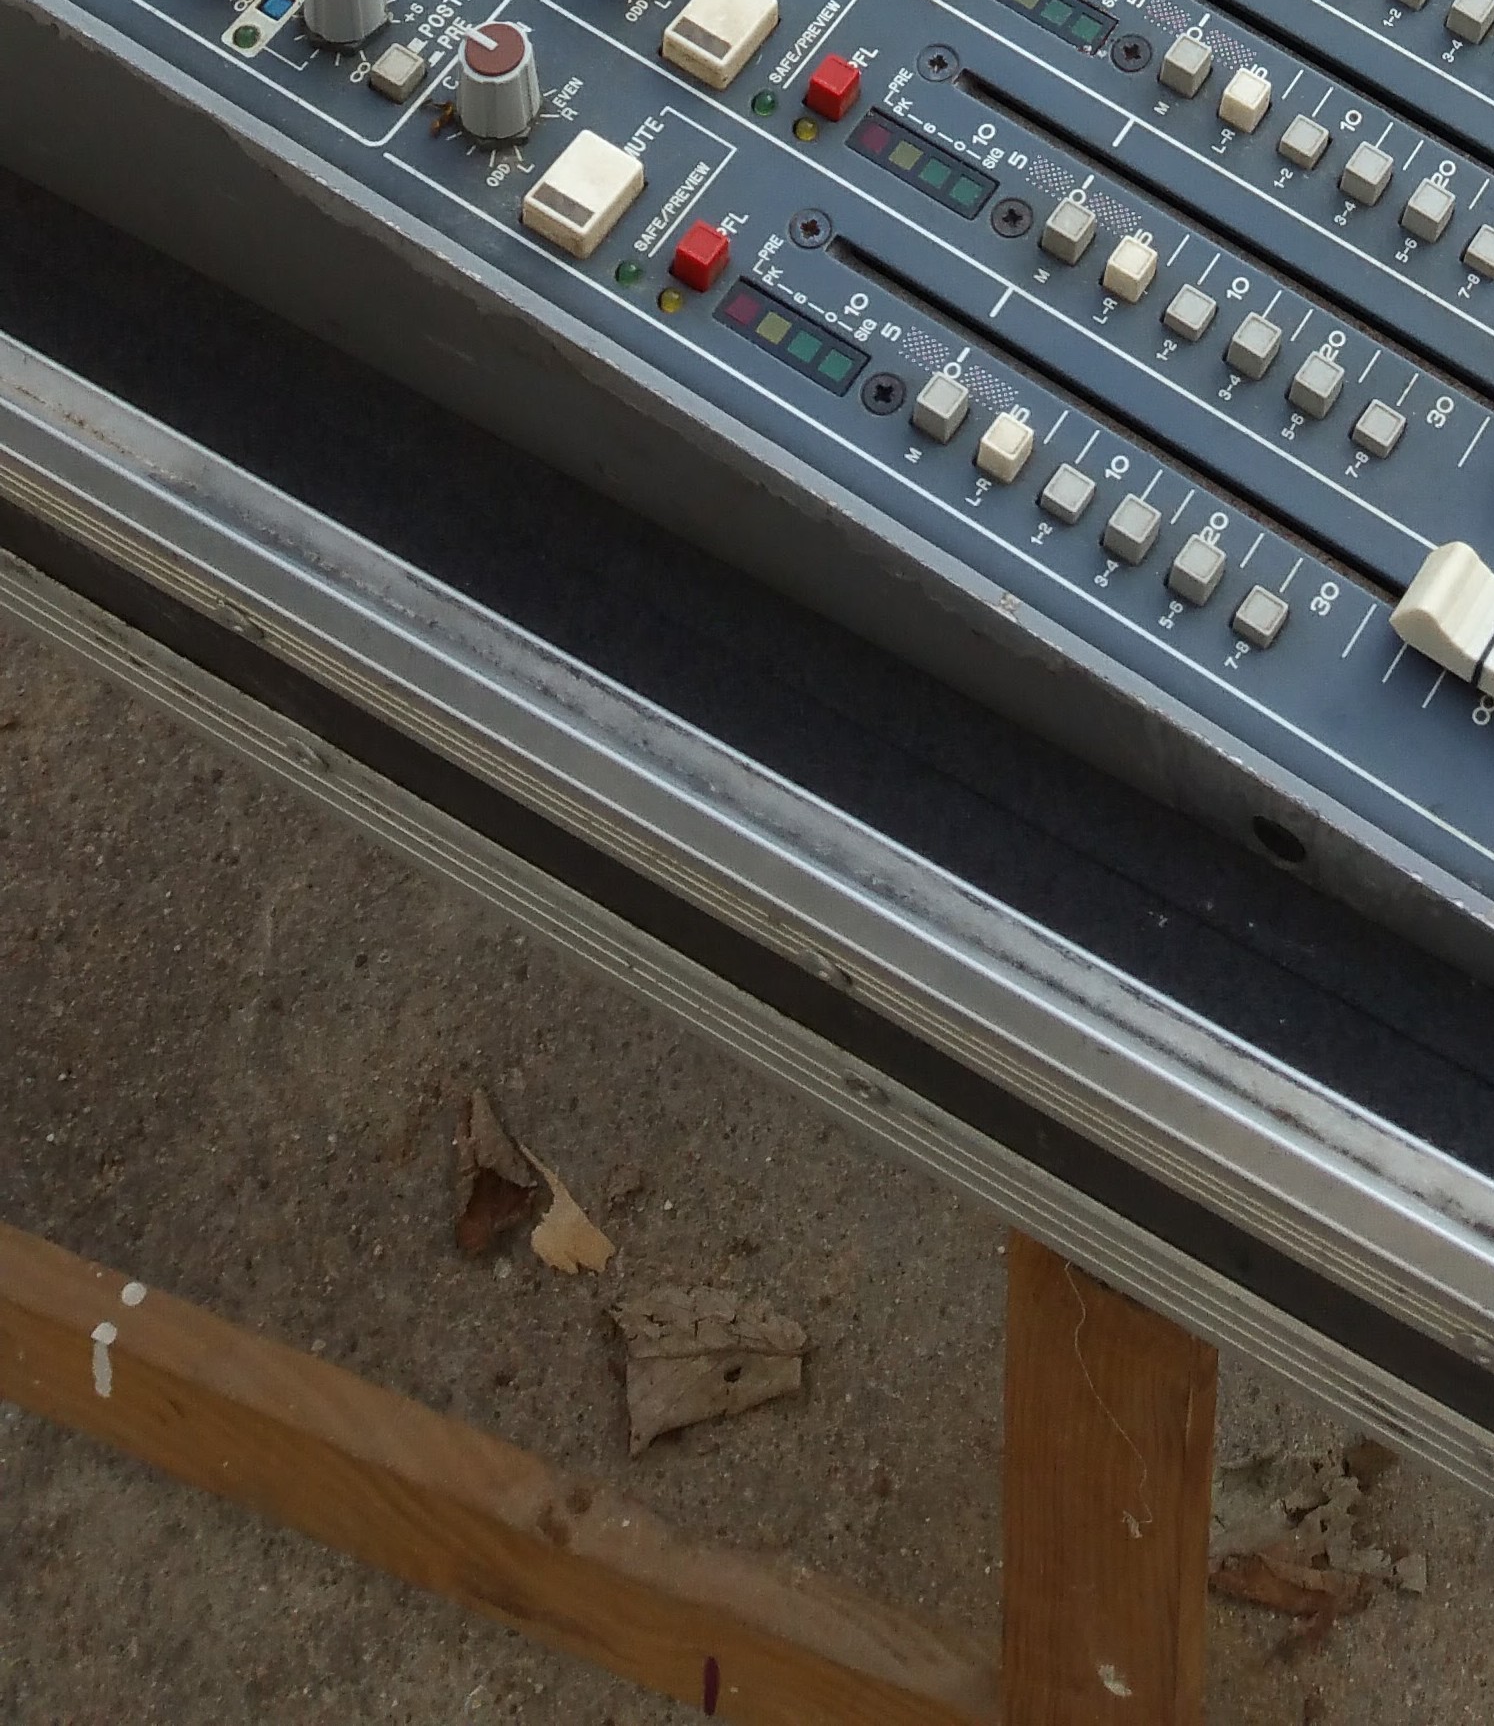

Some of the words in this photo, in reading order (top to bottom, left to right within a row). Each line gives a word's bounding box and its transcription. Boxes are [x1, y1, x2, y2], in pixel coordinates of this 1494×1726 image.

[403, 2, 425, 23] +6
[1383, 9, 1402, 29] 1-2
[552, 77, 584, 108] EVEN
[889, 68, 913, 97] PRE
[893, 98, 913, 118] PK
[1155, 101, 1171, 116] M
[1339, 109, 1364, 134] 10
[972, 123, 996, 148] 10
[1210, 127, 1236, 154] L-R
[982, 148, 1005, 170] SIG
[1009, 152, 1029, 170] 5
[487, 162, 512, 187] ODD
[1272, 167, 1294, 189] 1-2
[633, 161, 711, 254] SAFE/PREVIEW
[1333, 201, 1358, 228] 3-4
[759, 233, 783, 265] PRE
[1395, 237, 1418, 264] 5-6
[762, 266, 782, 287] PK
[1033, 268, 1051, 284] M
[1225, 275, 1251, 301] 10
[1457, 273, 1482, 300] 7-8
[844, 293, 868, 318] 10
[1093, 297, 1118, 326] L-R
[854, 319, 879, 343] SIG
[881, 322, 903, 341] 5
[1155, 339, 1178, 362] 1-2
[1217, 374, 1242, 402] 3-4
[1427, 395, 1455, 429] 30
[1281, 412, 1305, 441] 5-6
[905, 448, 923, 464] M
[1105, 454, 1130, 480] 10
[1345, 450, 1370, 479] 7-8
[965, 477, 993, 507] L-R
[1031, 522, 1053, 546] 1-2
[1095, 560, 1120, 589] 3-4
[1310, 580, 1341, 617] 30
[1158, 600, 1185, 629] 5-6
[1225, 640, 1252, 672] 7-8
